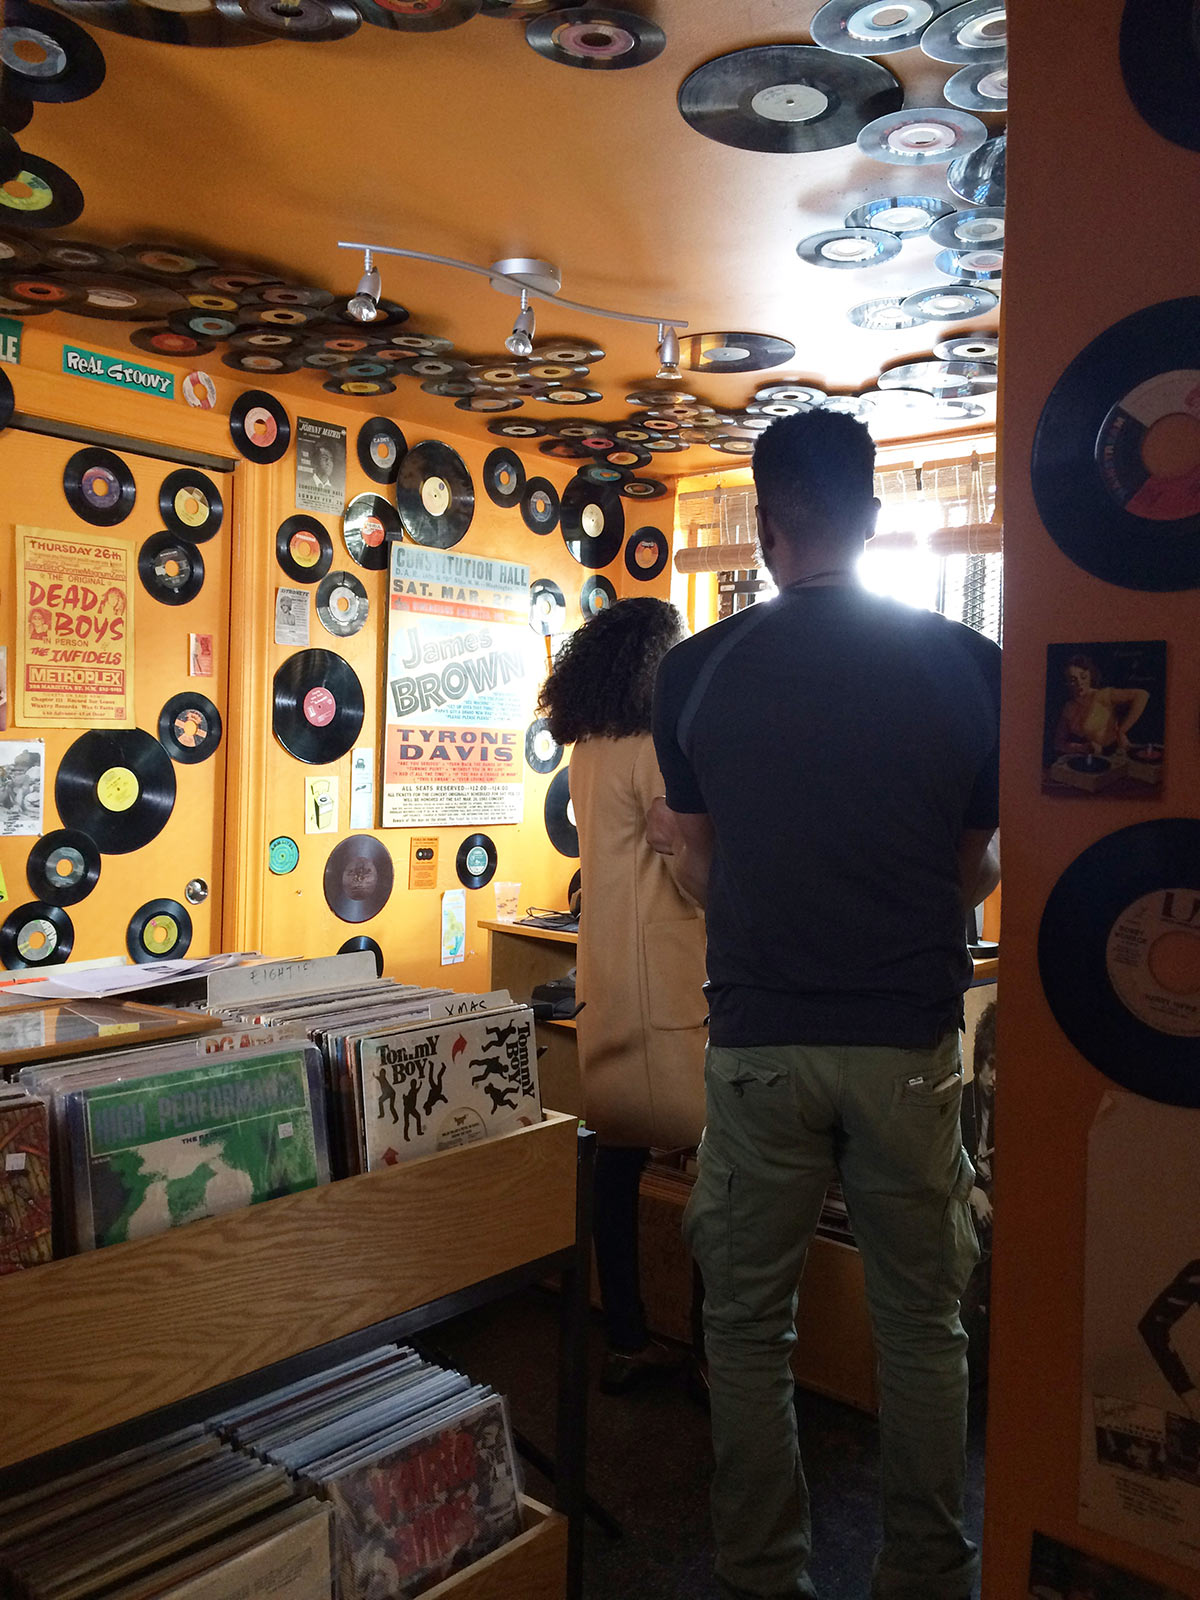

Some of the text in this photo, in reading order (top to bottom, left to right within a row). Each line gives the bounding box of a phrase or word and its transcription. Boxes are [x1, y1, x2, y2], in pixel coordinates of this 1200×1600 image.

[29, 539, 92, 557] THURSDAY
[94, 549, 122, 561] 26th
[396, 547, 527, 587] CONSTITUTION HALL
[48, 573, 105, 587] THE ORIGINAL
[393, 579, 433, 597] SAT.
[441, 586, 484, 603] MAR.
[28, 580, 99, 612] DEAD
[55, 612, 124, 643] BOYS
[55, 638, 89, 648] PERSON
[402, 627, 493, 669] James
[31, 647, 122, 666] THE INFIDELS
[30, 667, 122, 685] METROPLEX
[390, 649, 526, 718] BROWN
[397, 729, 517, 745] TYRONE
[400, 744, 513, 762] DAVIS
[92, 1102, 147, 1148] HIGH
[181, 1136, 198, 1145] THE
